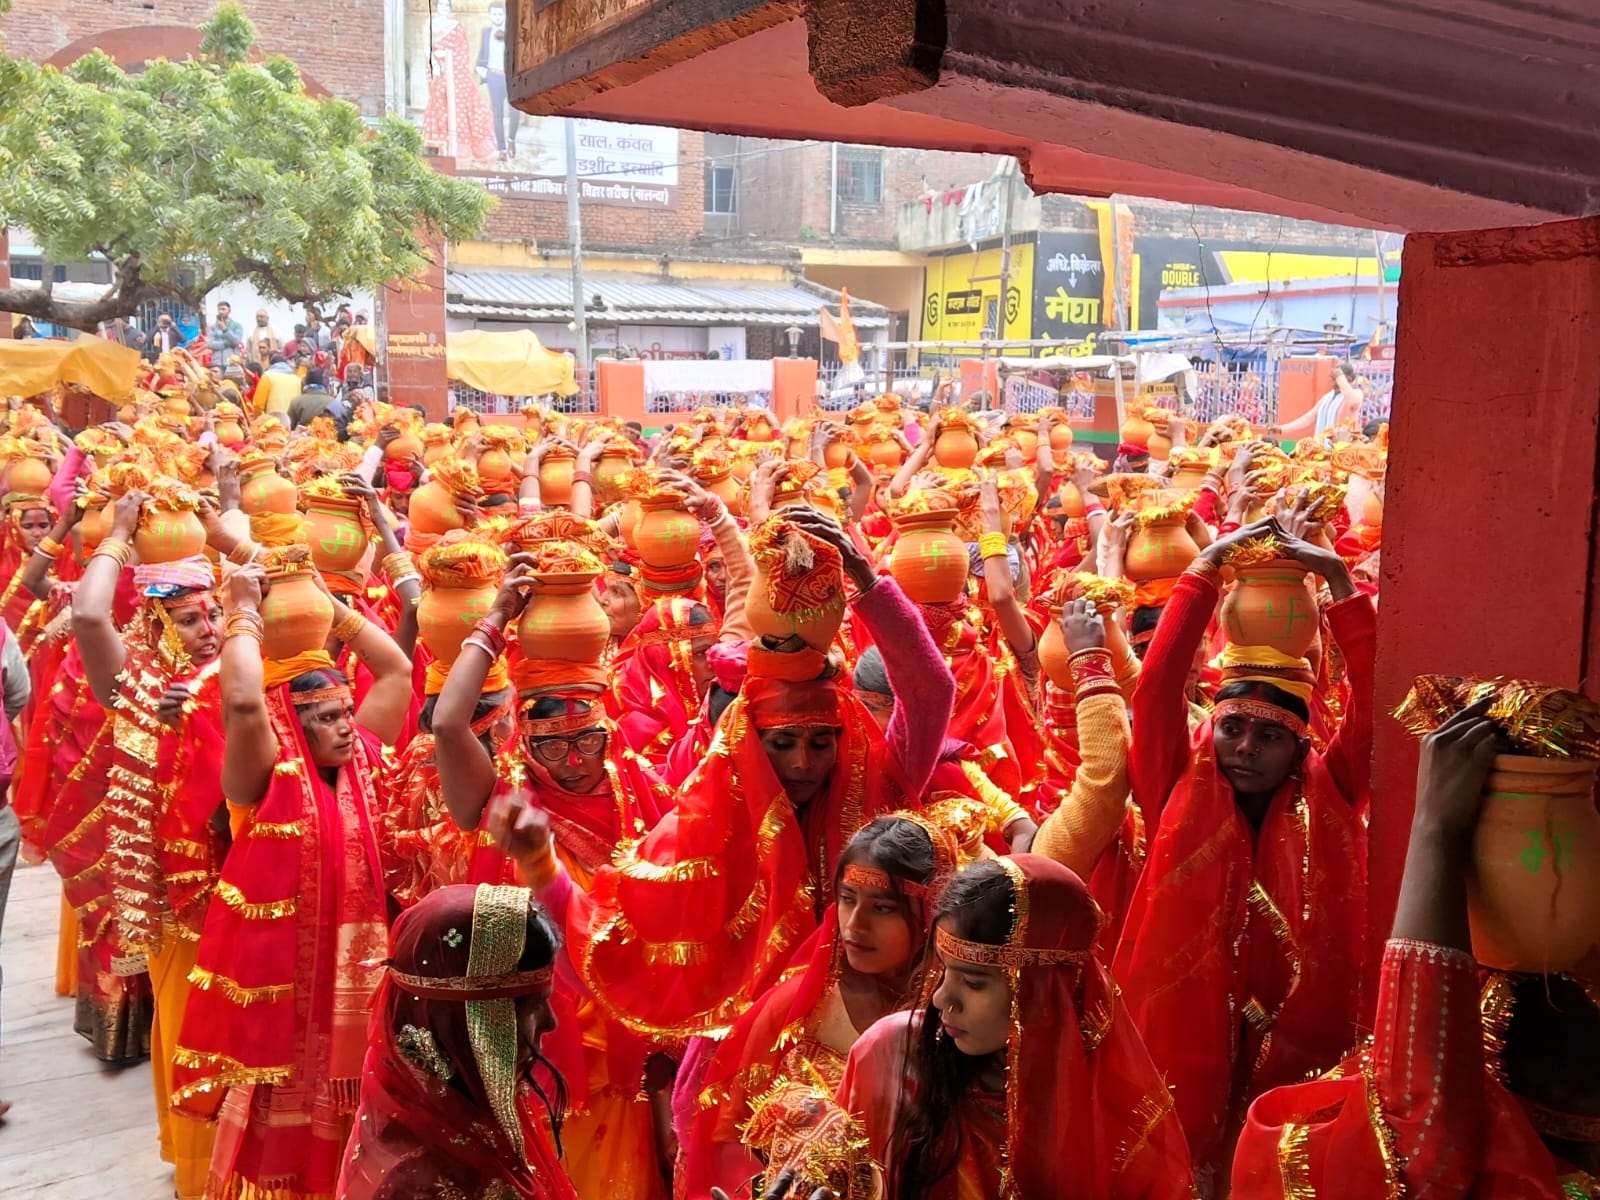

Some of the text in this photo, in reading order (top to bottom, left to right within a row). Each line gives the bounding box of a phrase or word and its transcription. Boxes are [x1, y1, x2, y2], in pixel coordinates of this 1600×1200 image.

[575, 155, 617, 173] डशीट
[1161, 270, 1200, 287] DOUBLE
[1044, 286, 1101, 325] मेघा
